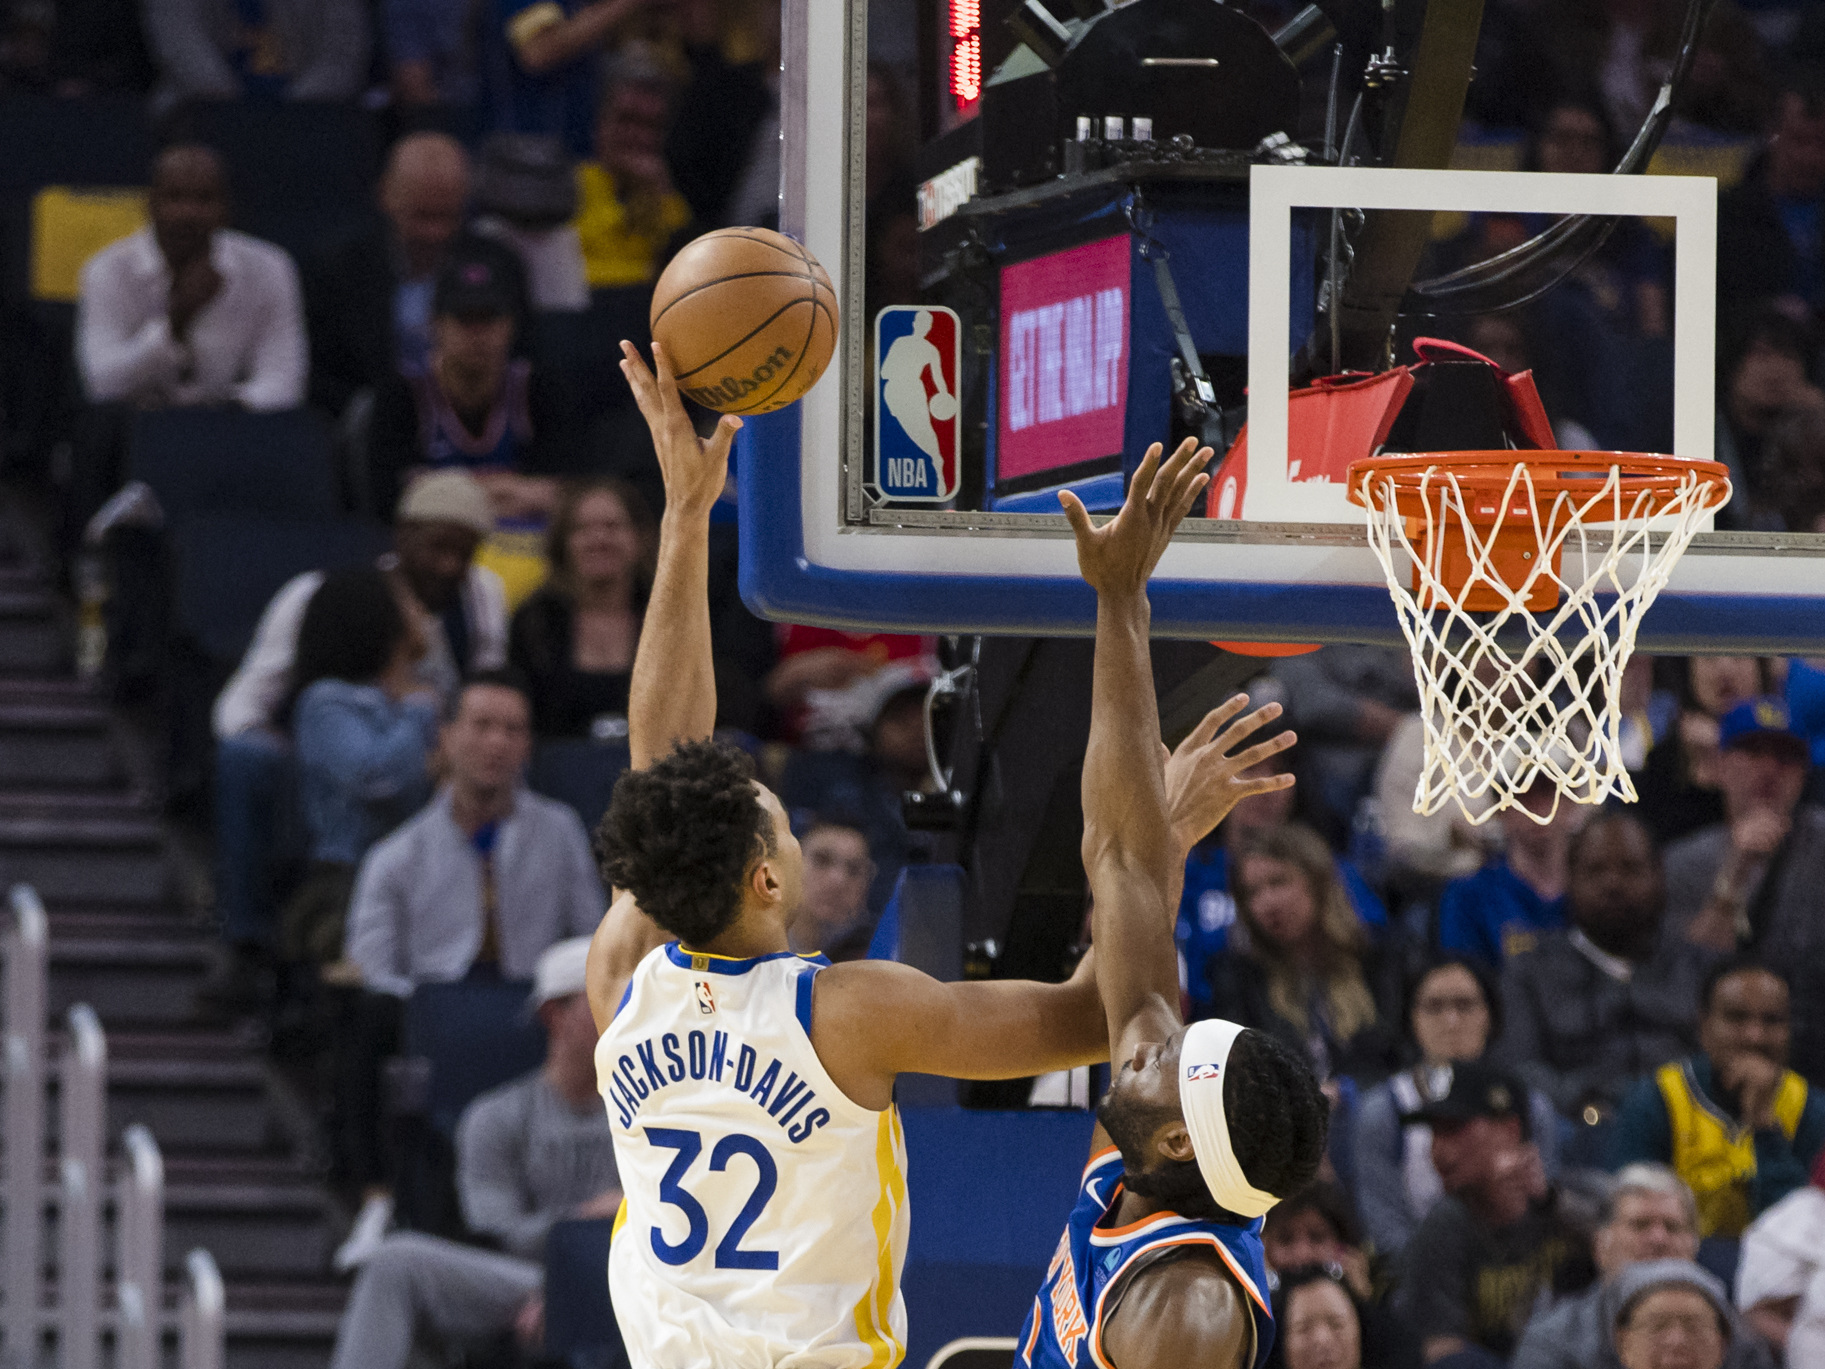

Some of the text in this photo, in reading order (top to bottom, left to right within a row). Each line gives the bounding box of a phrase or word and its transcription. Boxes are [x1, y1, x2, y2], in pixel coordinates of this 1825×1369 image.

[686, 345, 794, 407] Wilson
[887, 457, 928, 489] NBA
[609, 1029, 831, 1144] JACKSON-DAVIS
[642, 1126, 780, 1271] 32
